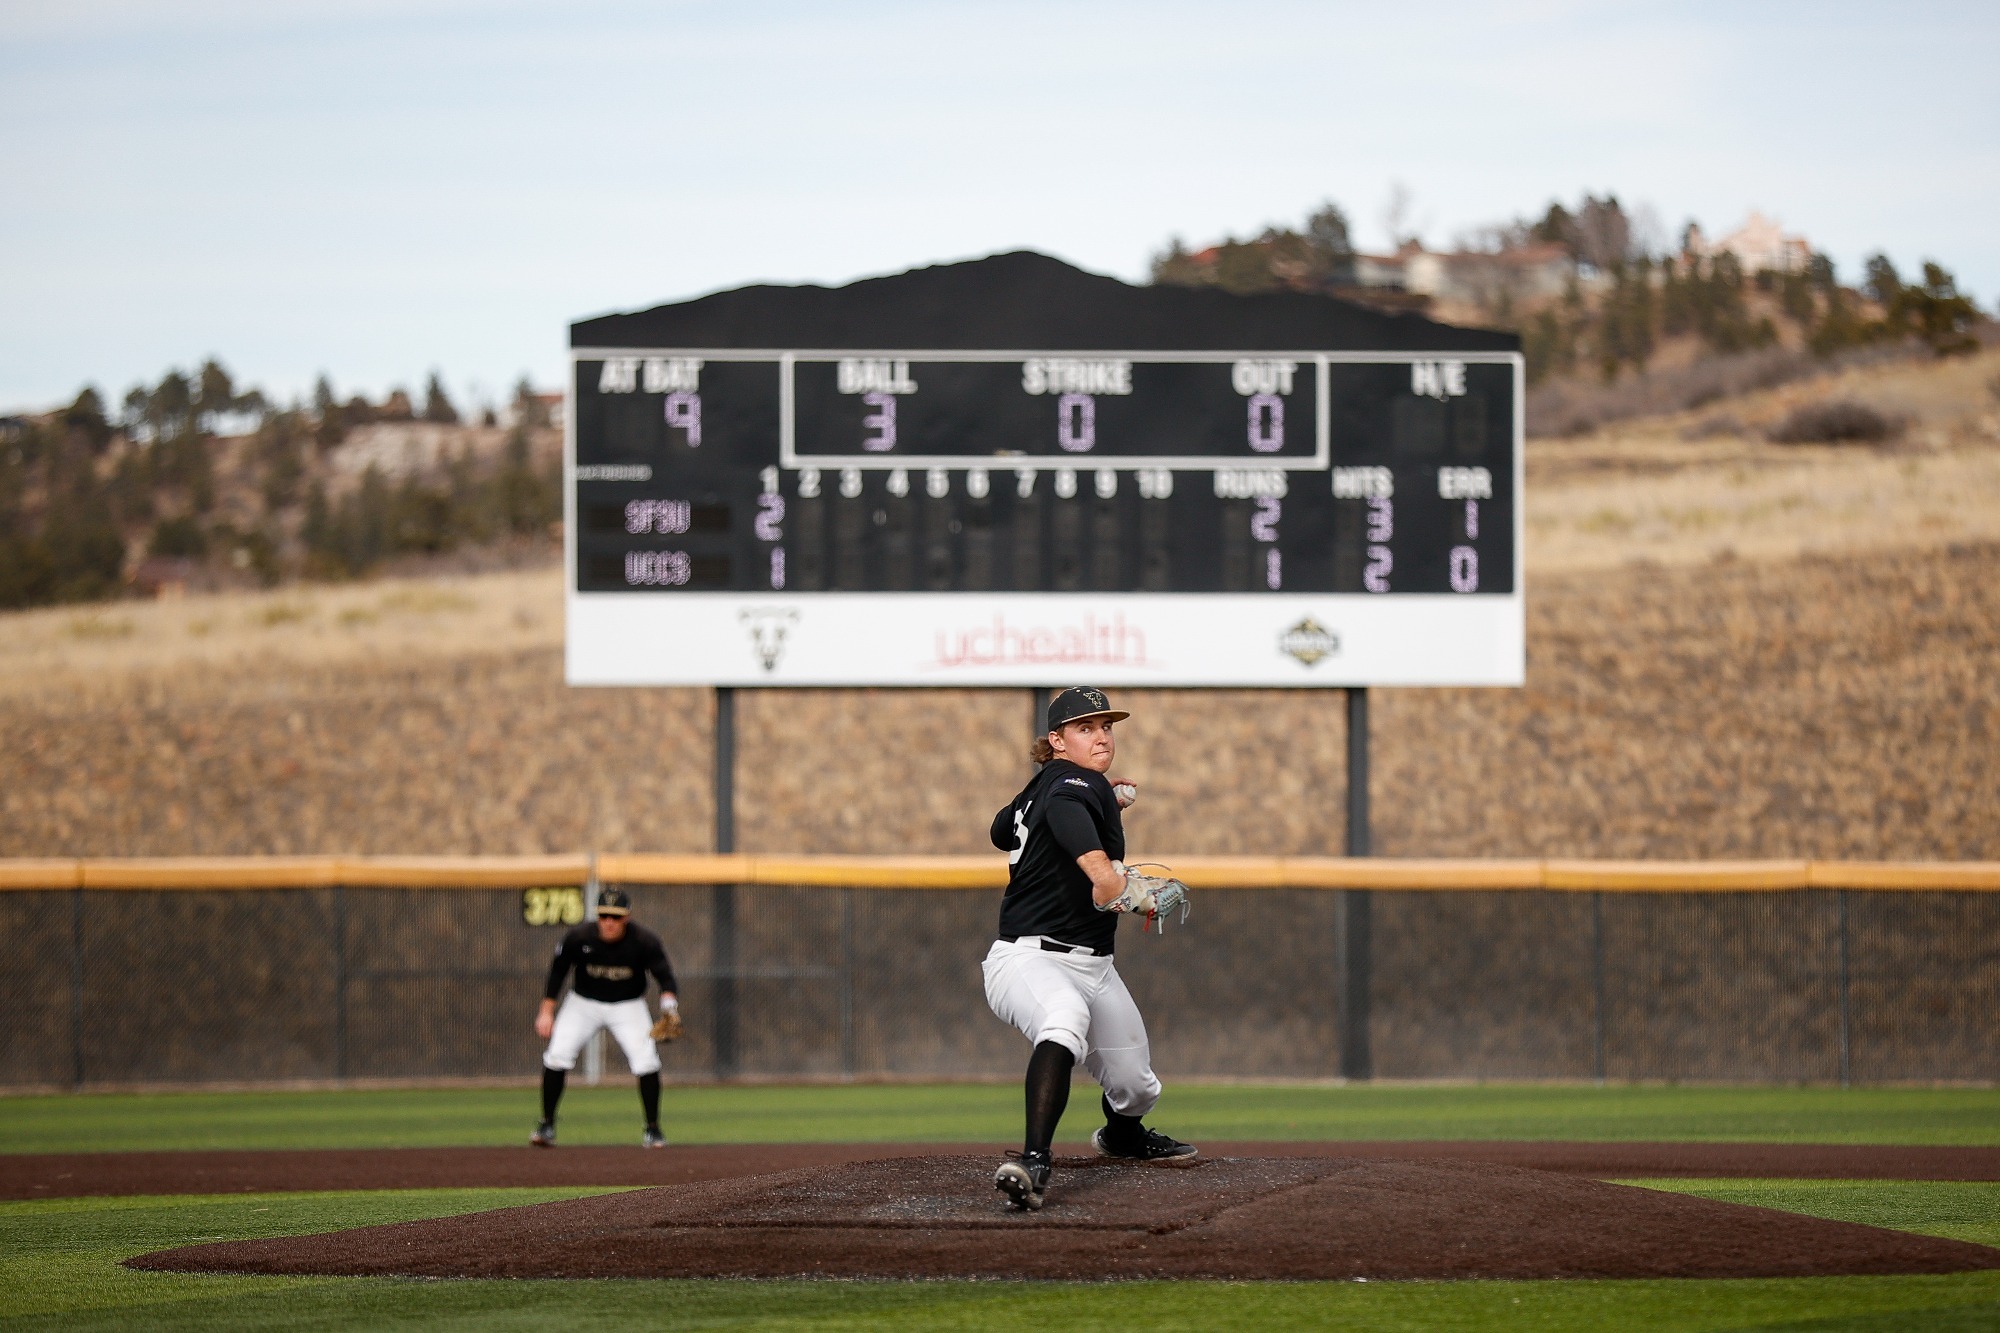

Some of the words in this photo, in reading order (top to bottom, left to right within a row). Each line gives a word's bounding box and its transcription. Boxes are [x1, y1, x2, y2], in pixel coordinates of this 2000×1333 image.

[599, 359, 641, 394] AT
[642, 359, 704, 394] BAT
[836, 359, 917, 394] BALL
[1021, 359, 1133, 395] STRIKE
[1231, 360, 1297, 395] OUT
[664, 392, 701, 448] 9
[862, 393, 897, 451] 3
[1058, 393, 1095, 452] 0
[1247, 394, 1284, 453] 0
[759, 466, 778, 495] 1
[798, 468, 821, 498] 2
[839, 469, 863, 498] 3
[887, 469, 909, 498] 4
[926, 469, 950, 498] 5
[965, 469, 991, 498] 6
[1014, 469, 1037, 498] 7
[1054, 469, 1078, 498] 8
[1094, 469, 1118, 498] 9
[1135, 467, 1174, 498] 10
[1213, 467, 1288, 499] RUNS
[1332, 467, 1394, 499] HITS
[1437, 467, 1493, 499] ERR
[754, 494, 785, 541] 2
[1251, 496, 1281, 542] 2
[1366, 496, 1393, 542] 3
[1464, 498, 1478, 540] 1
[770, 546, 785, 590] 1
[1267, 548, 1281, 590] 1
[1363, 545, 1393, 593] 2
[1449, 545, 1479, 593] 0
[935, 611, 1147, 665] uchealth
